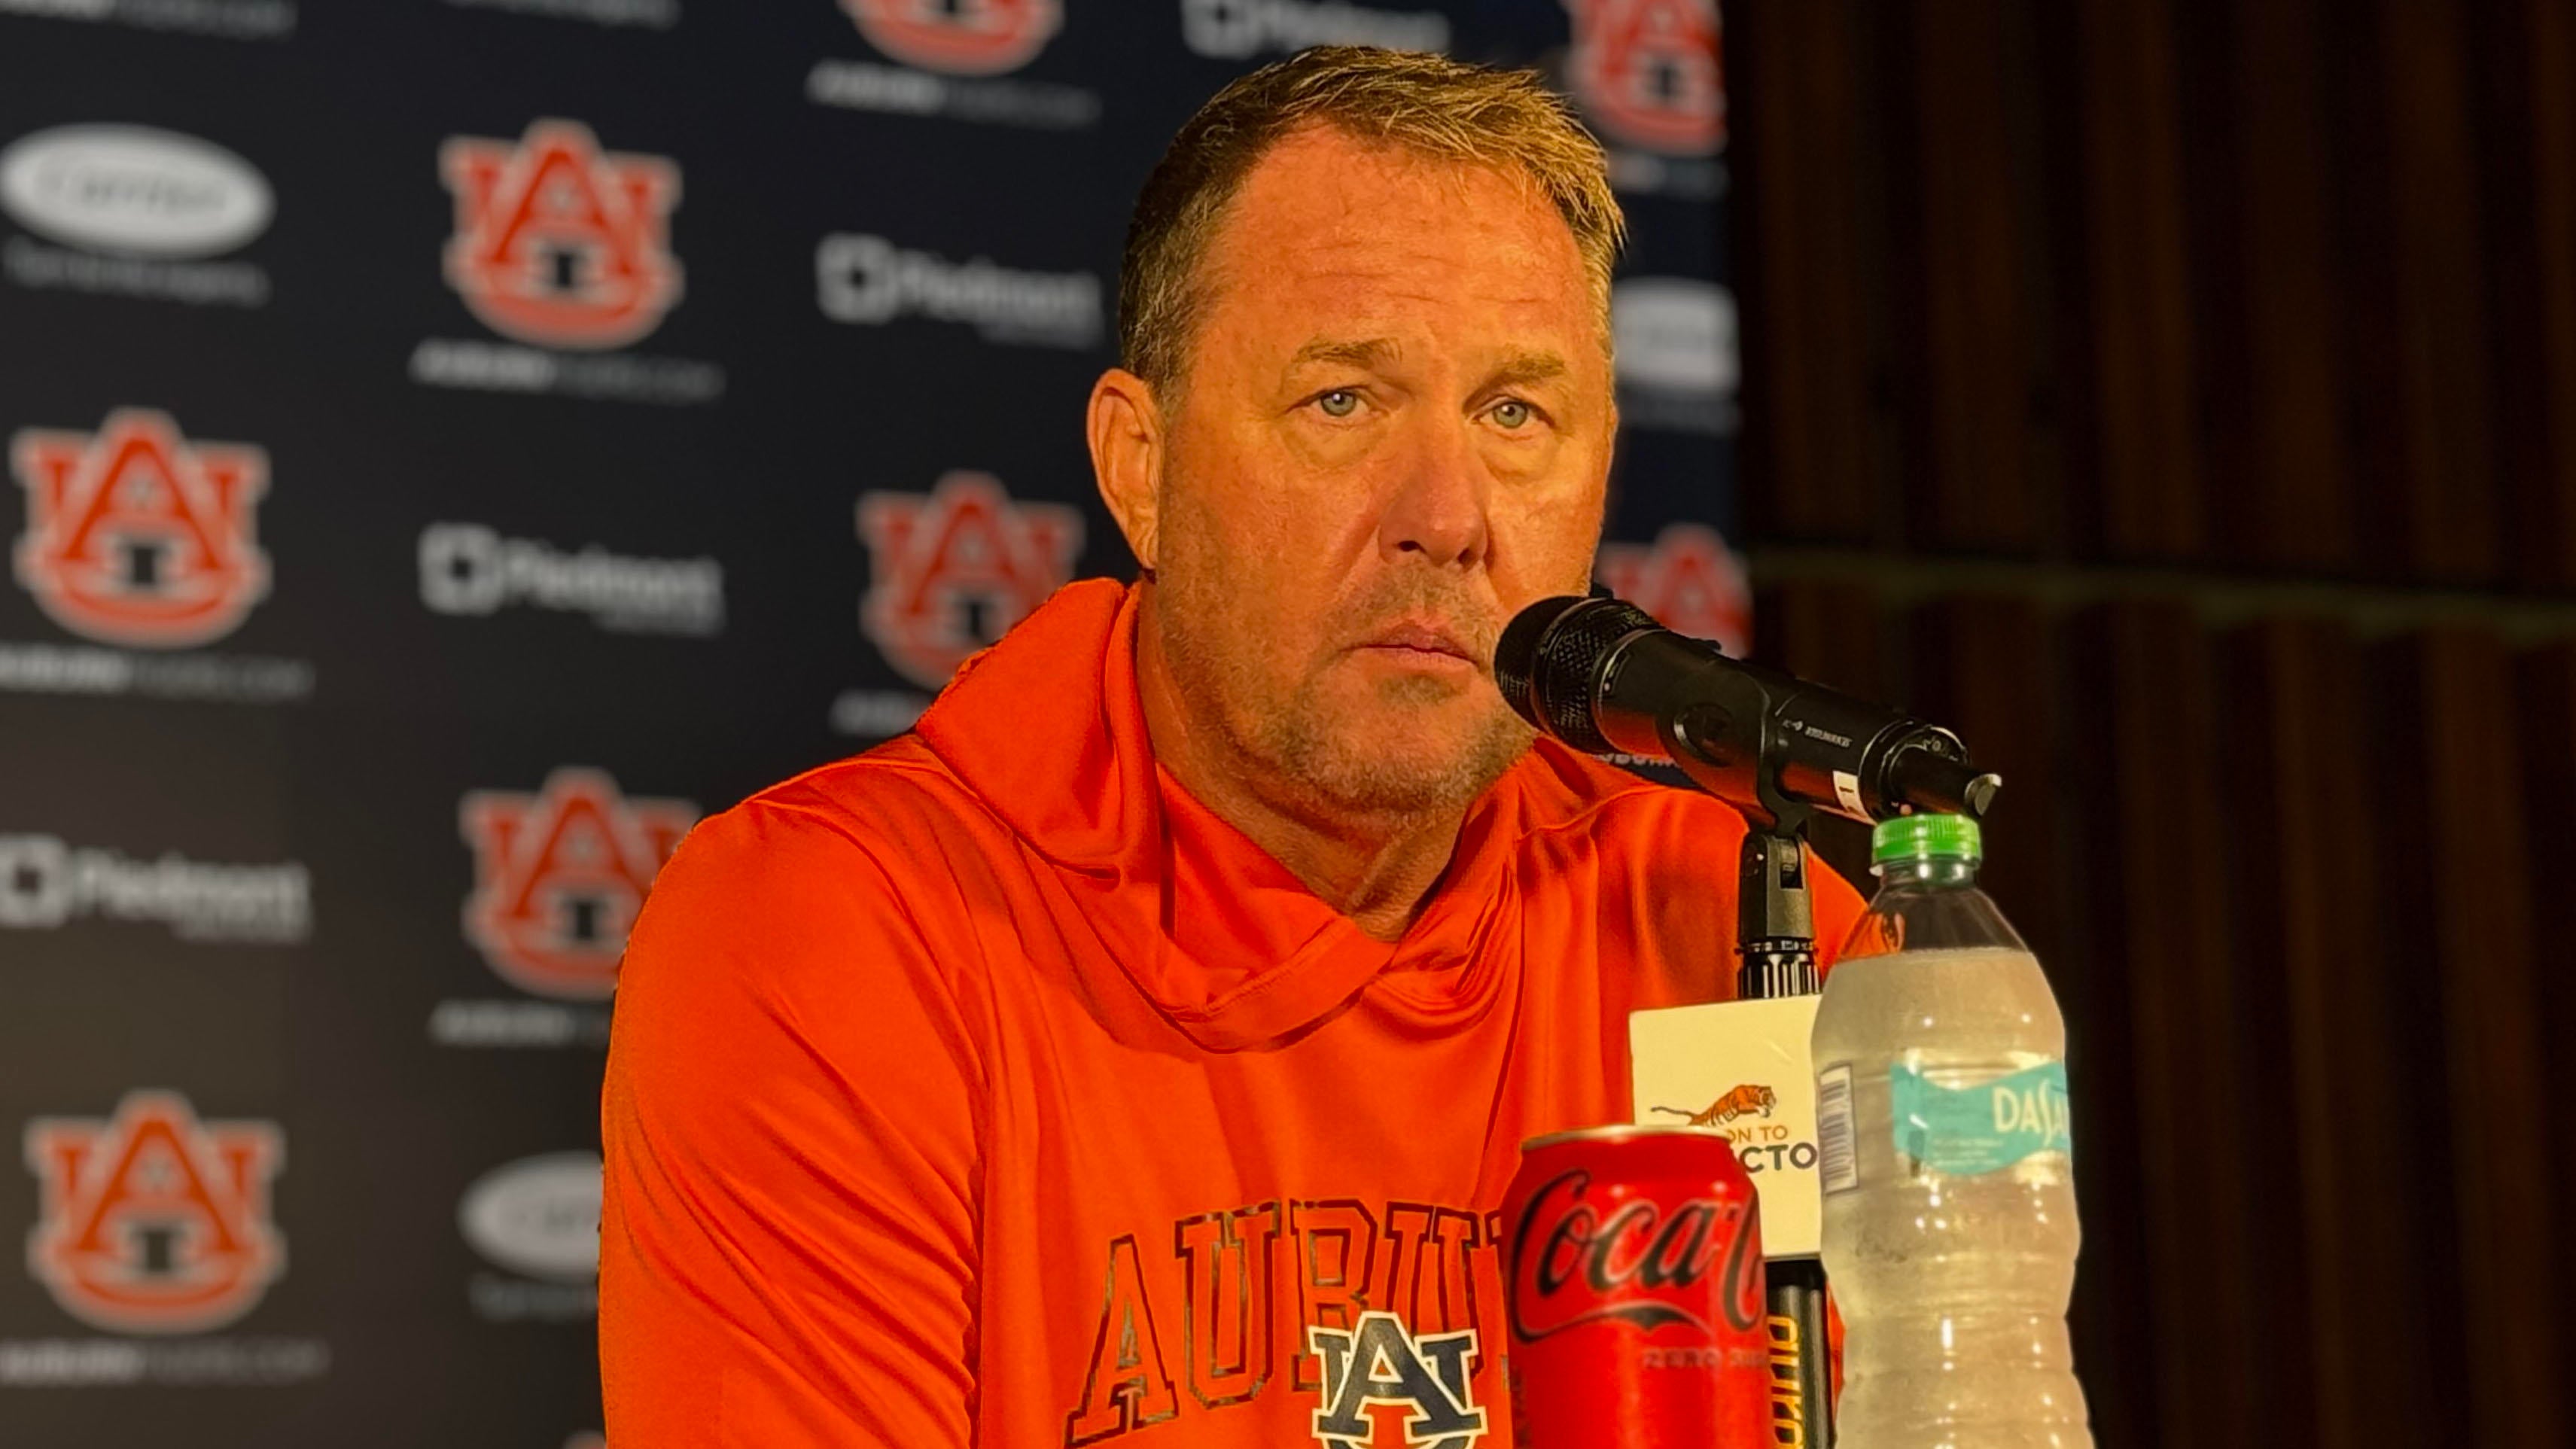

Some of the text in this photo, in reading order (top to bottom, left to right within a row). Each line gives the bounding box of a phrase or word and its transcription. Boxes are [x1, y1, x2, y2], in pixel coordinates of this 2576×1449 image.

[1759, 1125, 1788, 1141] TO
[1739, 1142, 1817, 1173] CTO
[1064, 1198, 1507, 1449] AUBU
